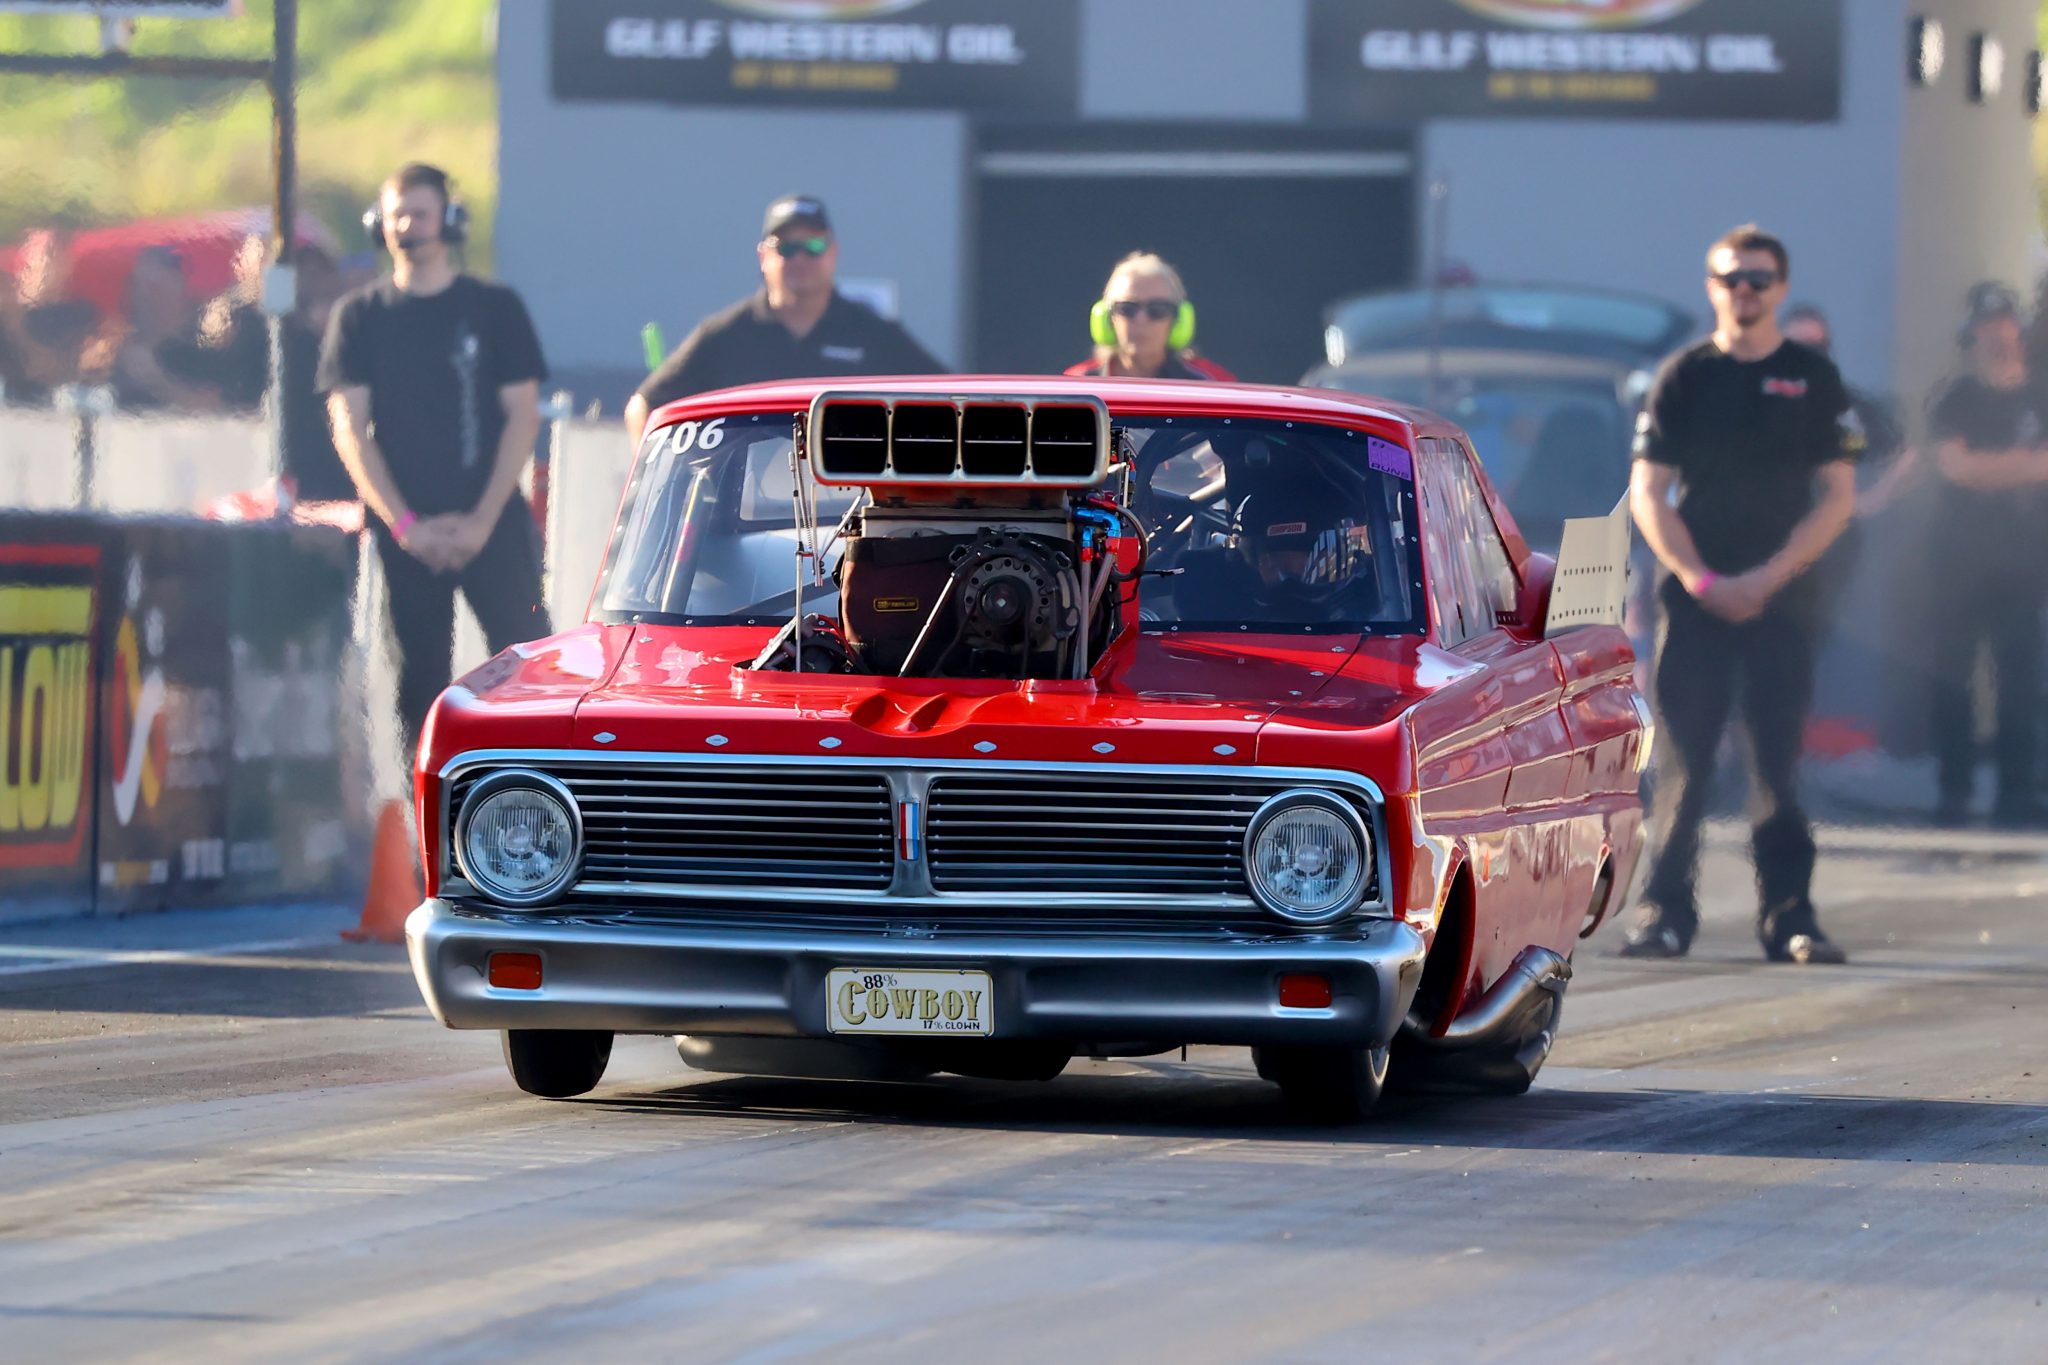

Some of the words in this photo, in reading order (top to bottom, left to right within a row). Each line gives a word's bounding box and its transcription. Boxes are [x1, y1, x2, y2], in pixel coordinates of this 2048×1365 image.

[606, 18, 721, 58] GULF
[729, 20, 941, 62] WESTERN
[947, 23, 1024, 64] OIL
[1361, 31, 1477, 70] GULF
[1485, 32, 1698, 71] WESTERN
[1706, 34, 1783, 73] OIL
[645, 417, 726, 464] 706
[837, 980, 982, 1025] COWBOY
[863, 974, 898, 990] 88%
[923, 1020, 943, 1030] 17%
[945, 1021, 980, 1030] CLOWN
